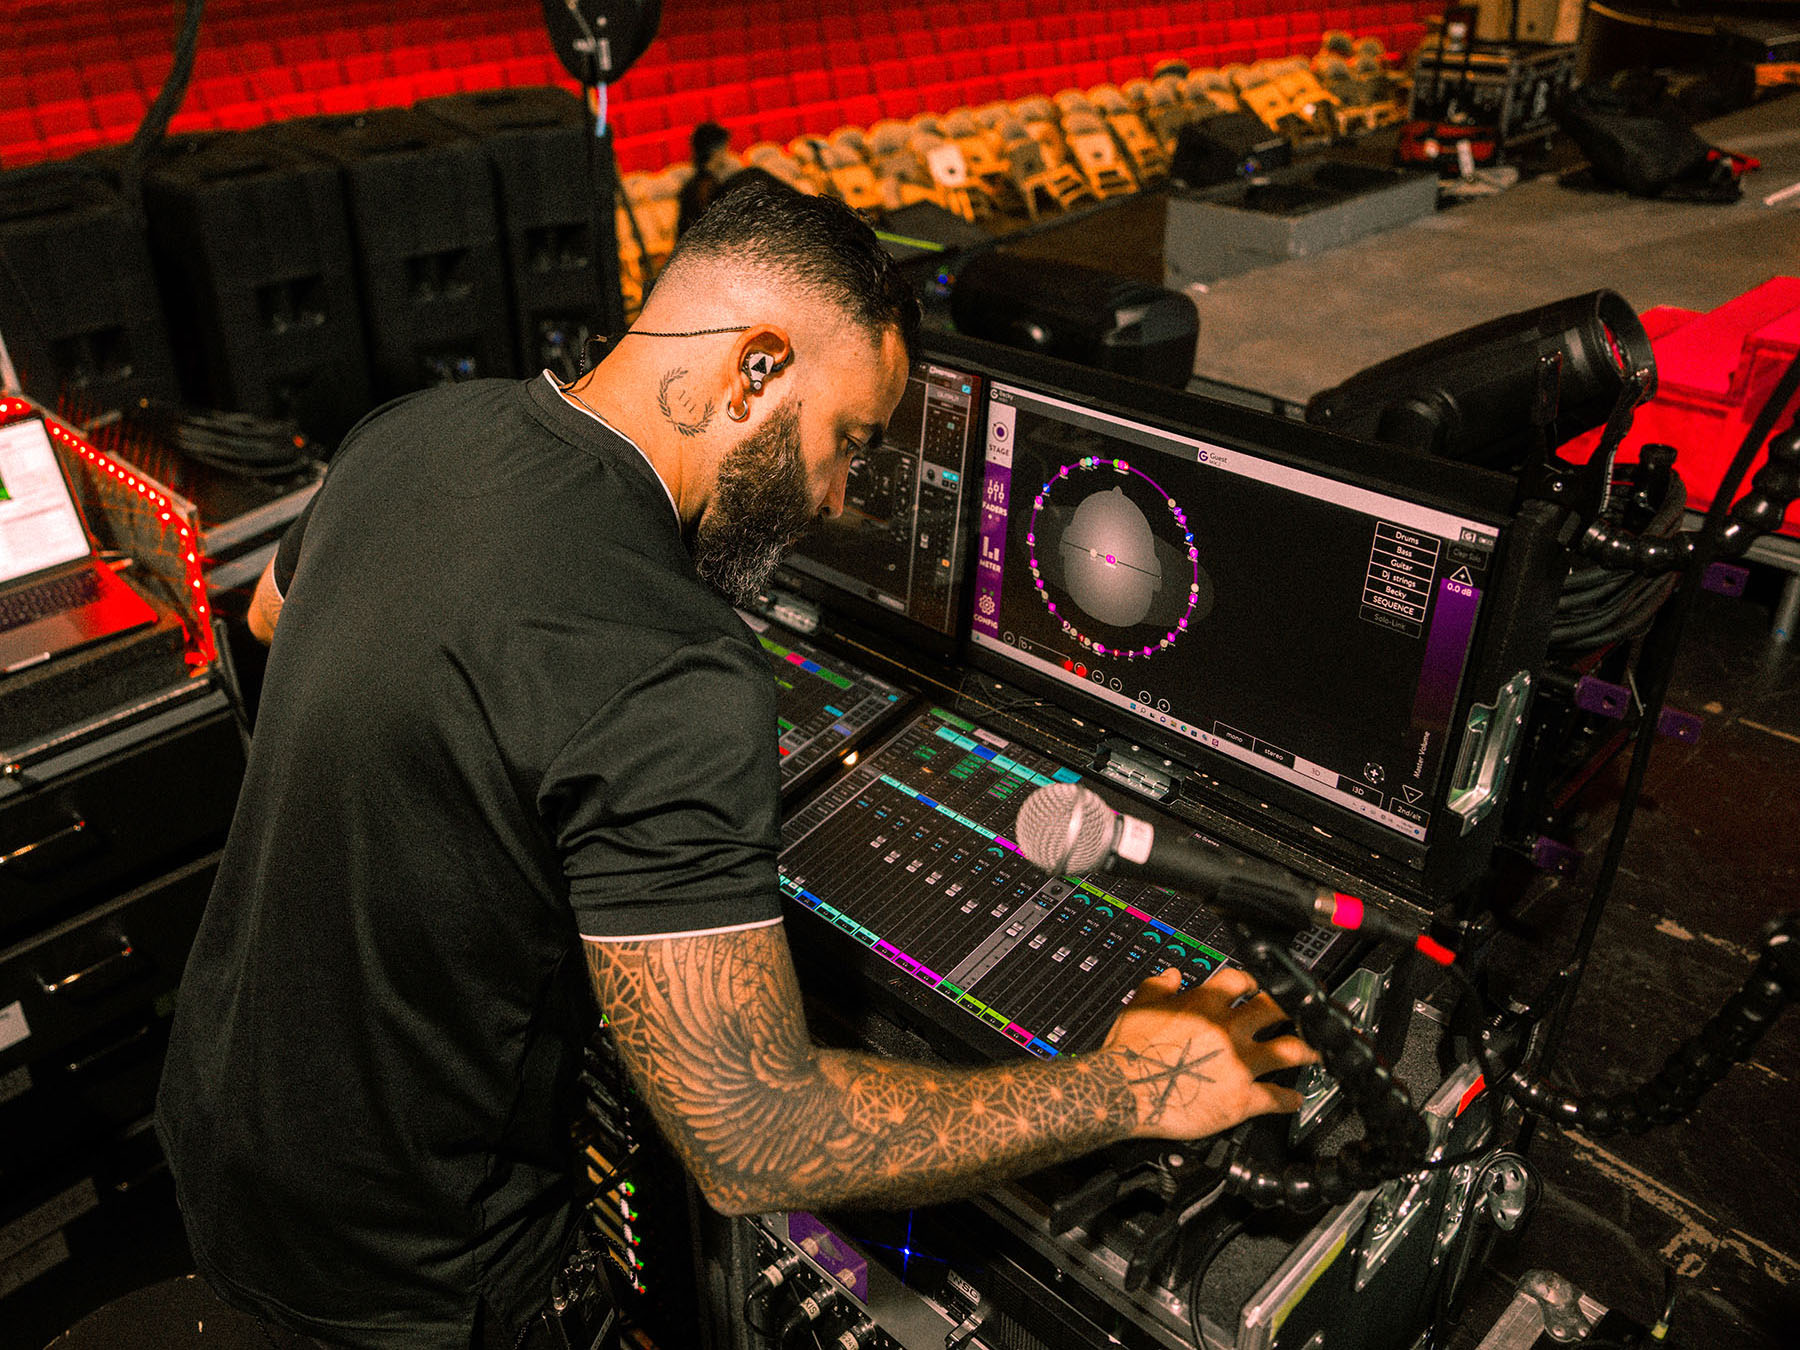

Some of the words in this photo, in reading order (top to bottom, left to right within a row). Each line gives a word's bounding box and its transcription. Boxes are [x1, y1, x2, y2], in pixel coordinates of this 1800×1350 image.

[988, 444, 1010, 456] STAGE
[1209, 452, 1228, 464] Guest
[982, 501, 1008, 517] FADERS
[1395, 531, 1419, 545] Drums
[1396, 546, 1413, 558] Bass
[979, 558, 1001, 573] METER
[1390, 559, 1413, 571] Guitar
[1392, 575, 1417, 588] strings
[1385, 585, 1408, 600] Becky
[1447, 582, 1461, 593] 0.0
[1461, 588, 1473, 597] dB
[1372, 595, 1416, 616] SEQUENCE
[973, 613, 999, 630] CONFIG
[1225, 732, 1243, 743] mono
[1264, 748, 1284, 761] stereo
[1412, 755, 1424, 779] Master
[1418, 730, 1431, 755] Volume
[949, 1272, 979, 1299] WSG
